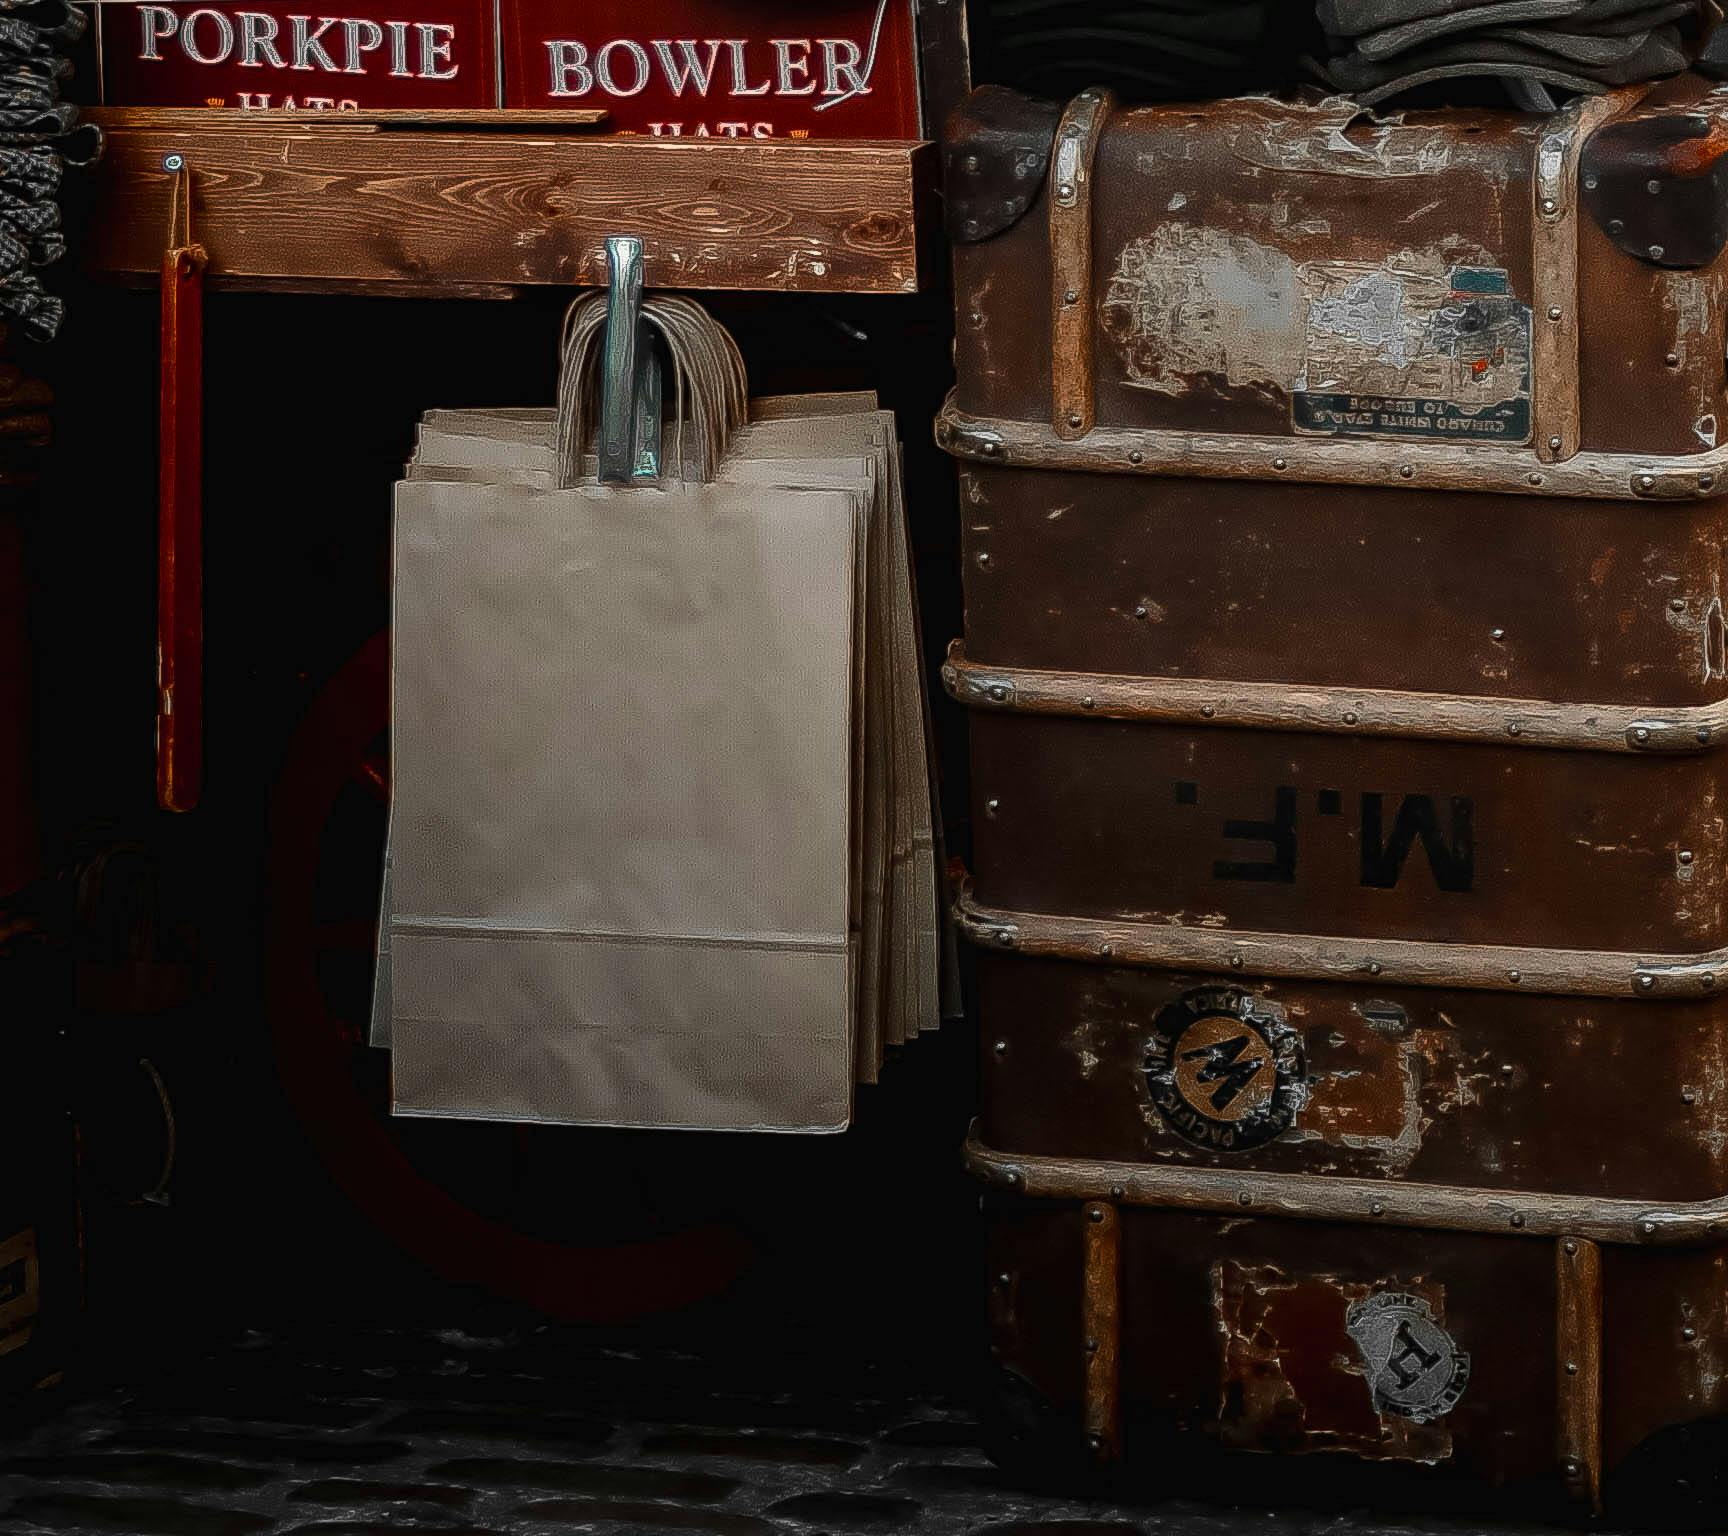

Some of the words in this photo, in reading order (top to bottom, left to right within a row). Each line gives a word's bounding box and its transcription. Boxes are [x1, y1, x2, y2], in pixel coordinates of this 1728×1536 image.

[136, 3, 461, 81] PORKPIE
[543, 38, 874, 100] BOWLER
[1175, 781, 1476, 892] M.F.
